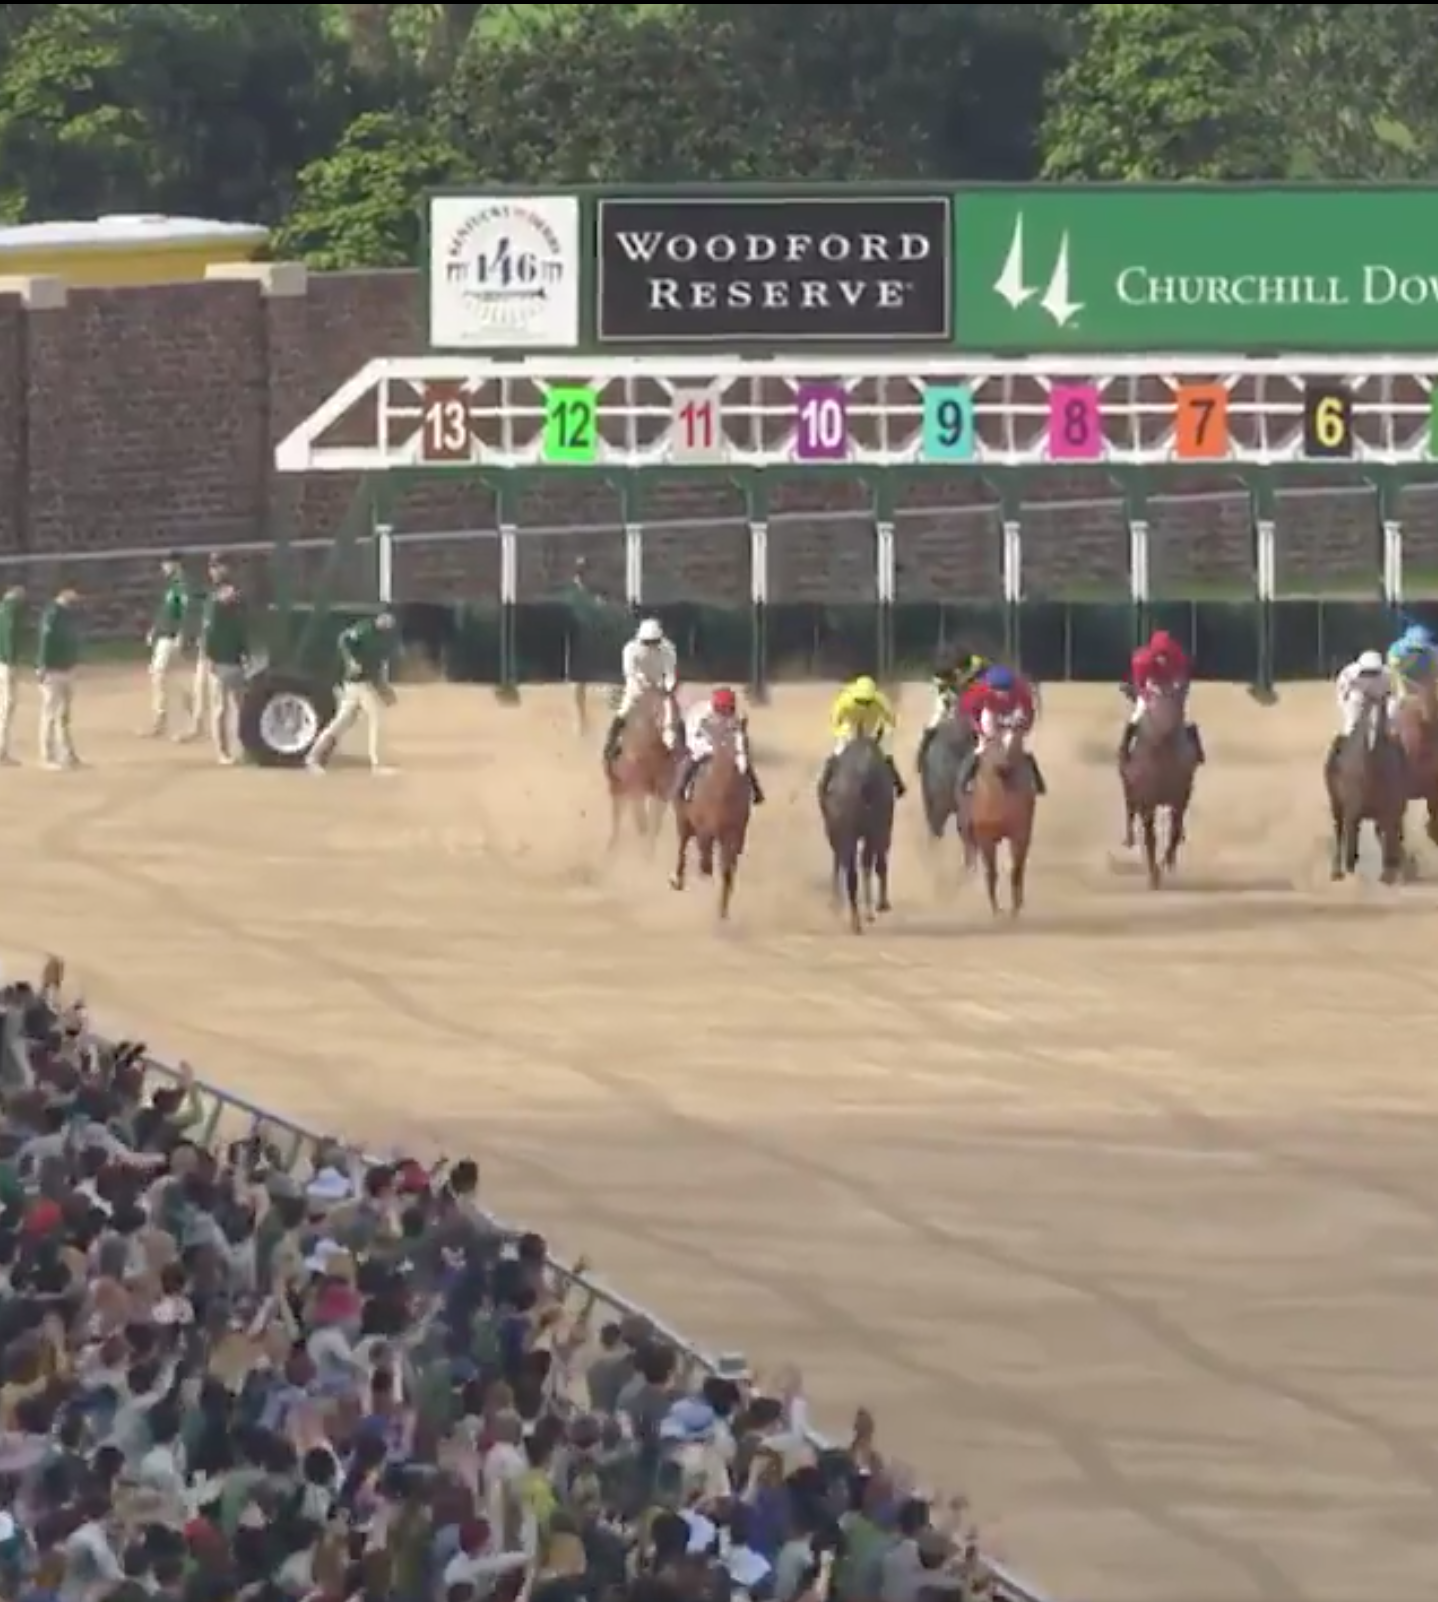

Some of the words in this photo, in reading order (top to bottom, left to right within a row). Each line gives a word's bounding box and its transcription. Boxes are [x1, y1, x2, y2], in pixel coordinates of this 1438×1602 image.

[477, 236, 537, 287] 146
[614, 231, 931, 263] WOODFORD
[648, 278, 905, 308] RESERVE
[1115, 265, 1348, 304] CHURCHILL
[425, 401, 467, 450] 13
[551, 401, 591, 448] 12
[679, 401, 713, 448] 11
[802, 399, 842, 448] 10
[936, 400, 963, 447] 9
[1063, 398, 1089, 445] 8
[1188, 398, 1215, 446] 7
[1315, 397, 1344, 446] 6
